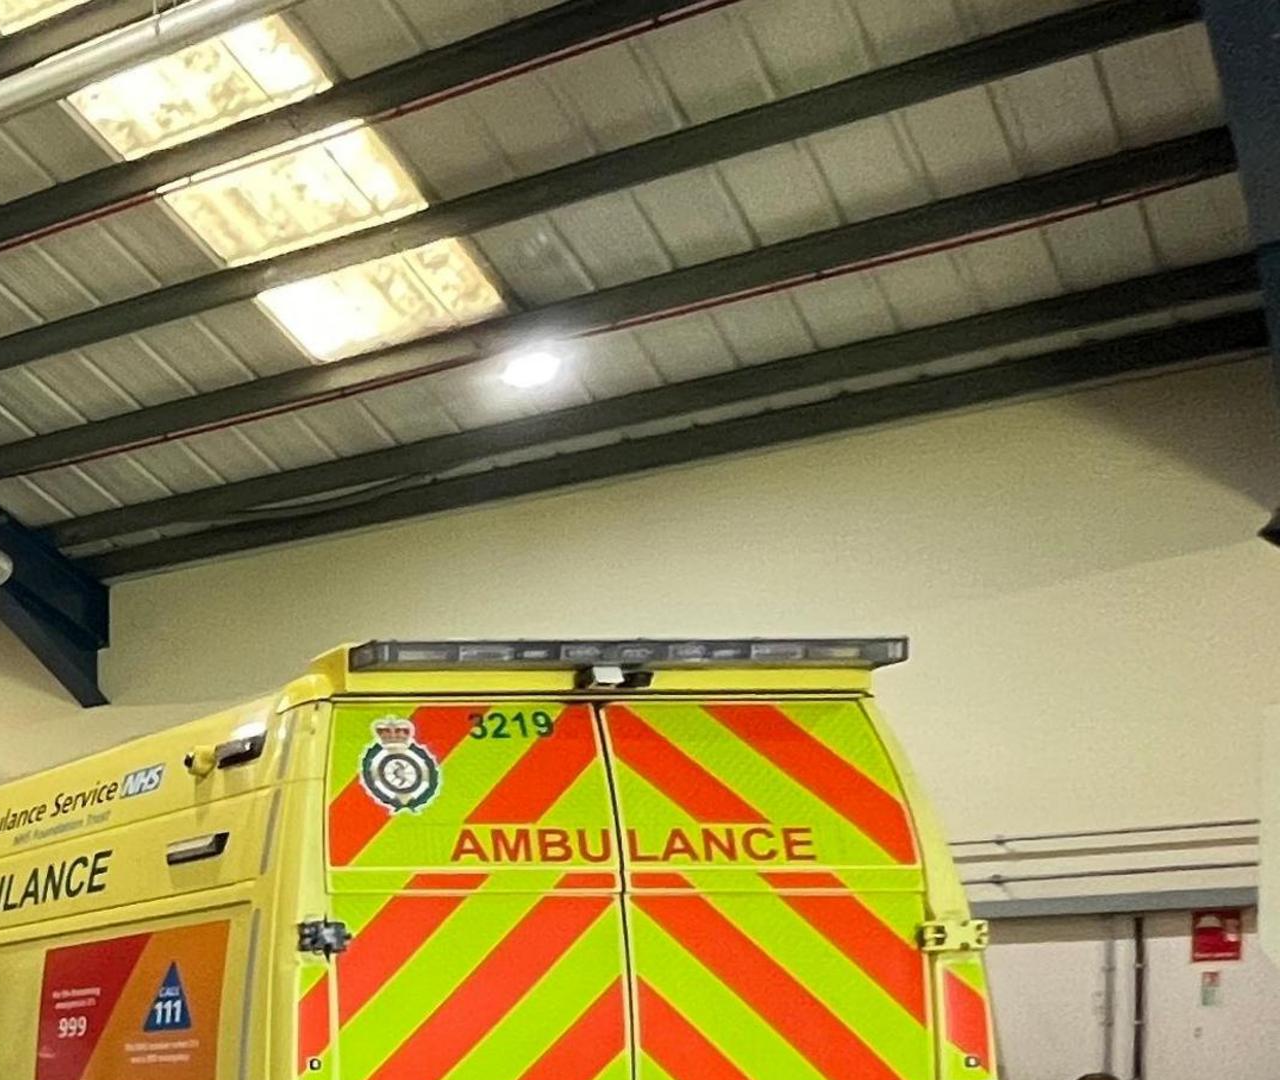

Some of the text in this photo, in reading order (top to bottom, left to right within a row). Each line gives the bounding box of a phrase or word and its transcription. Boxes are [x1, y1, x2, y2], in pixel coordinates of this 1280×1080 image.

[468, 711, 555, 740] 3219
[49, 780, 119, 819] Service
[123, 766, 164, 797] NHS
[450, 827, 817, 863] AMBULANCE
[153, 1000, 182, 1025] 111
[57, 1016, 88, 1039] 999
